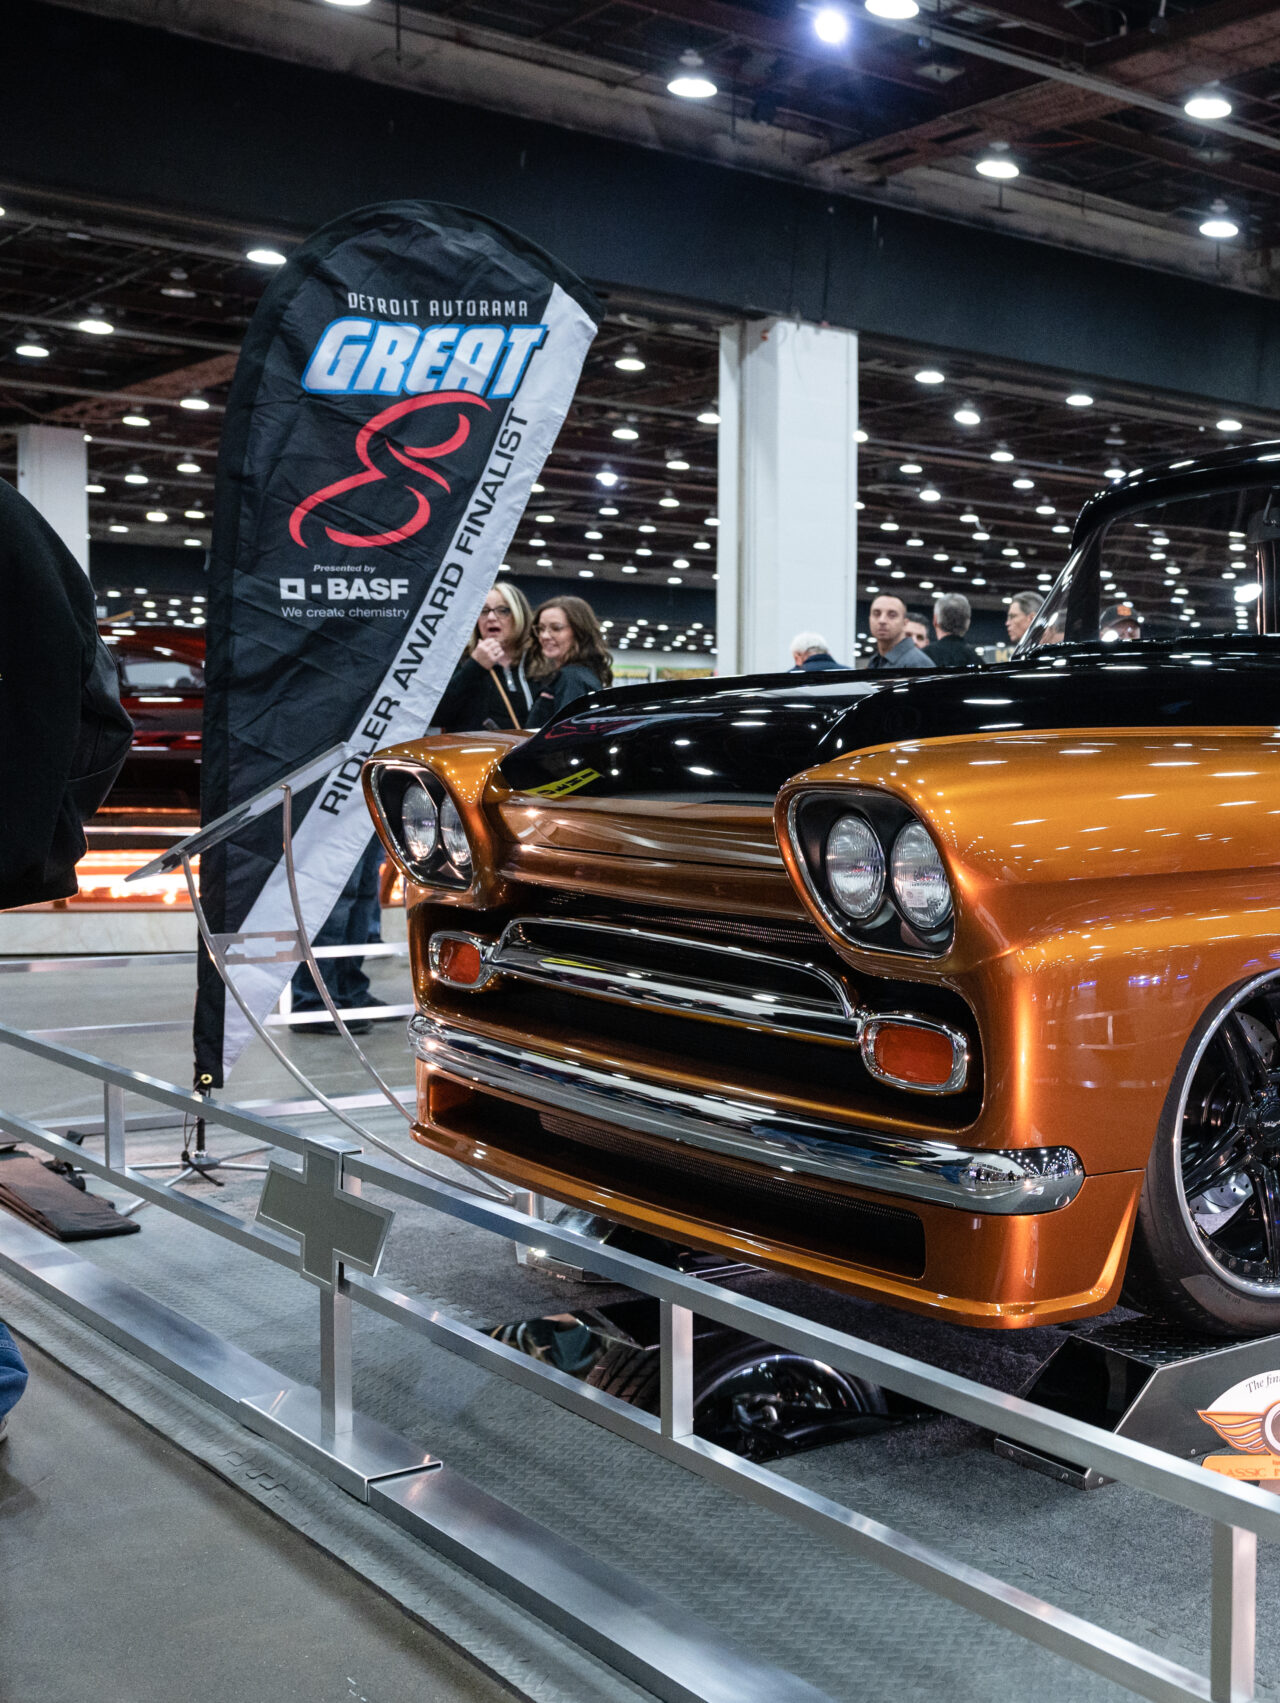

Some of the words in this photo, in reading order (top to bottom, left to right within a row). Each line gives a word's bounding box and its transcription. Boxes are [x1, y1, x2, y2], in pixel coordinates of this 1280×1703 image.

[347, 292, 419, 316] DETROIT
[429, 300, 528, 317] AUTORAMA
[302, 316, 549, 399] GREAT
[313, 564, 361, 573] Presented
[363, 565, 376, 574] by
[327, 578, 409, 600] BASF
[281, 607, 302, 617] We
[306, 607, 345, 617] create
[348, 607, 410, 619] chemistry
[319, 696, 401, 816] RIDLER
[392, 561, 464, 691] AWARD
[455, 407, 529, 556] FINALIST
[1245, 1380, 1264, 1393] The
